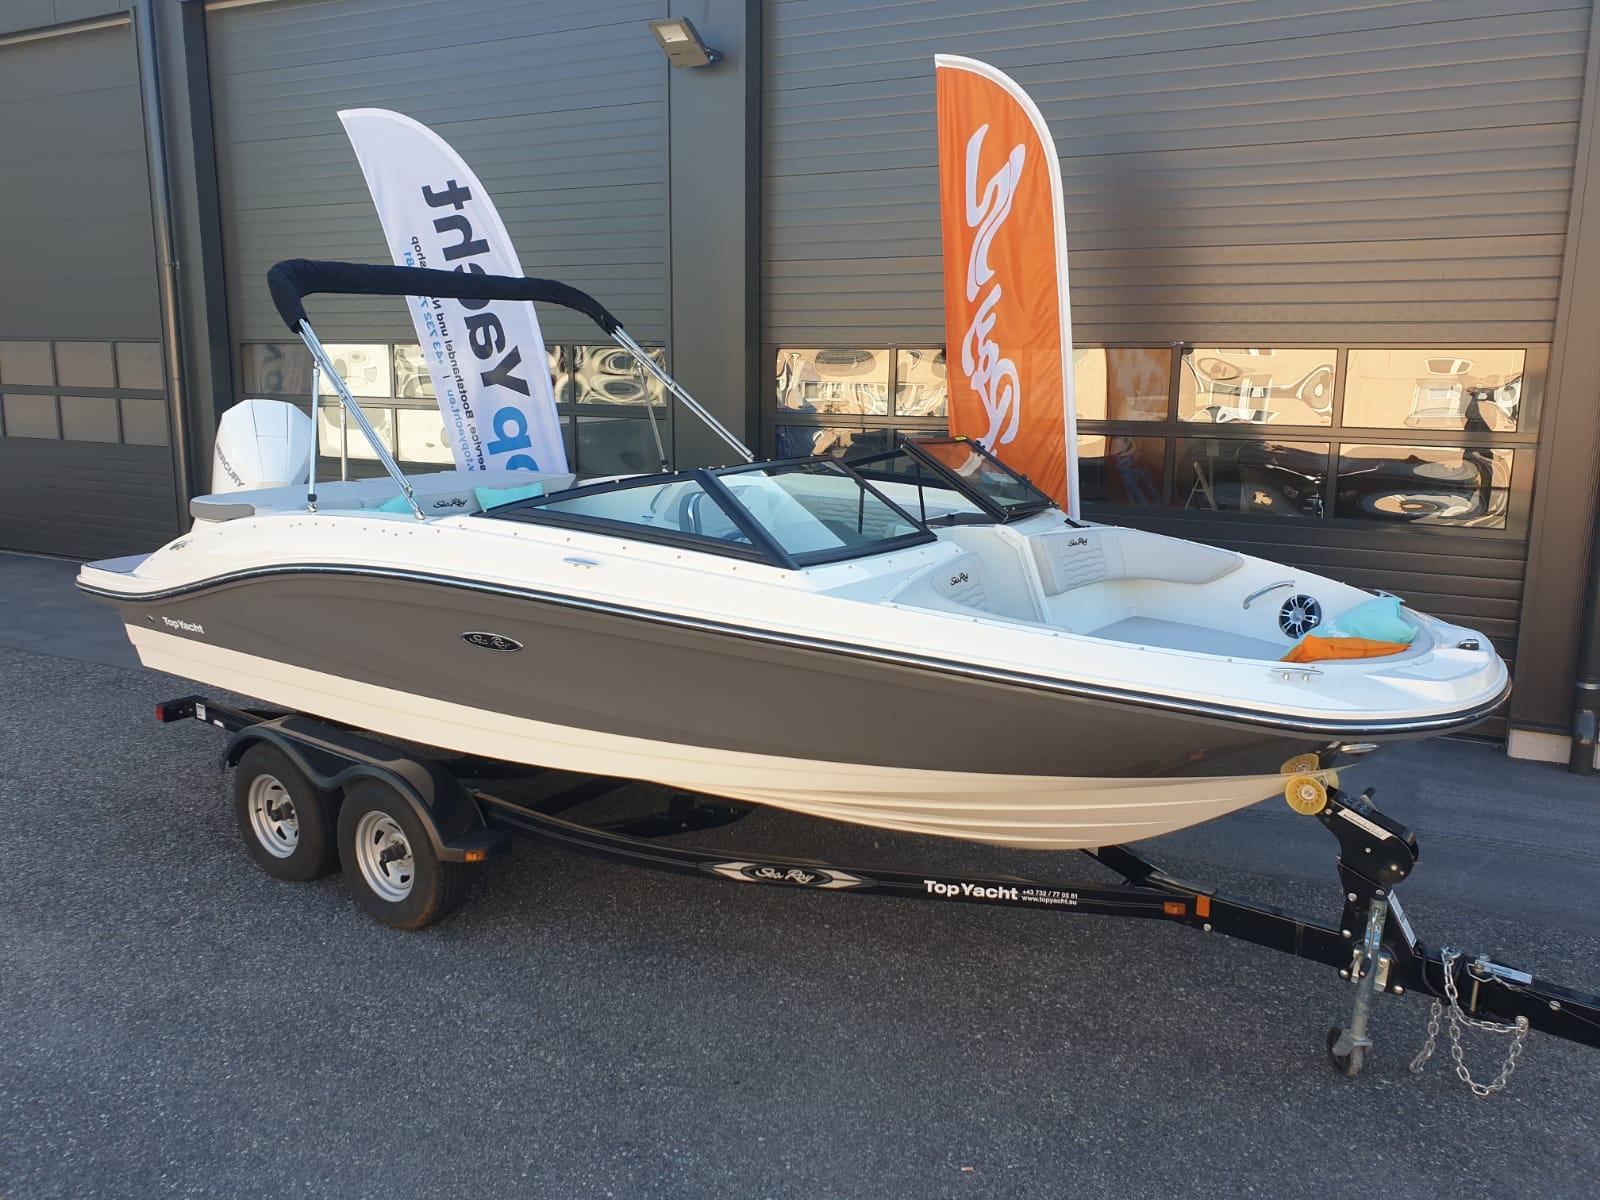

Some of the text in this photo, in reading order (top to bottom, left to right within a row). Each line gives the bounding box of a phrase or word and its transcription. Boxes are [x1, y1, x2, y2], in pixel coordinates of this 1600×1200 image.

[755, 867, 815, 885] Sea Ray
[1021, 895, 1078, 906] www.topyacht.eu
